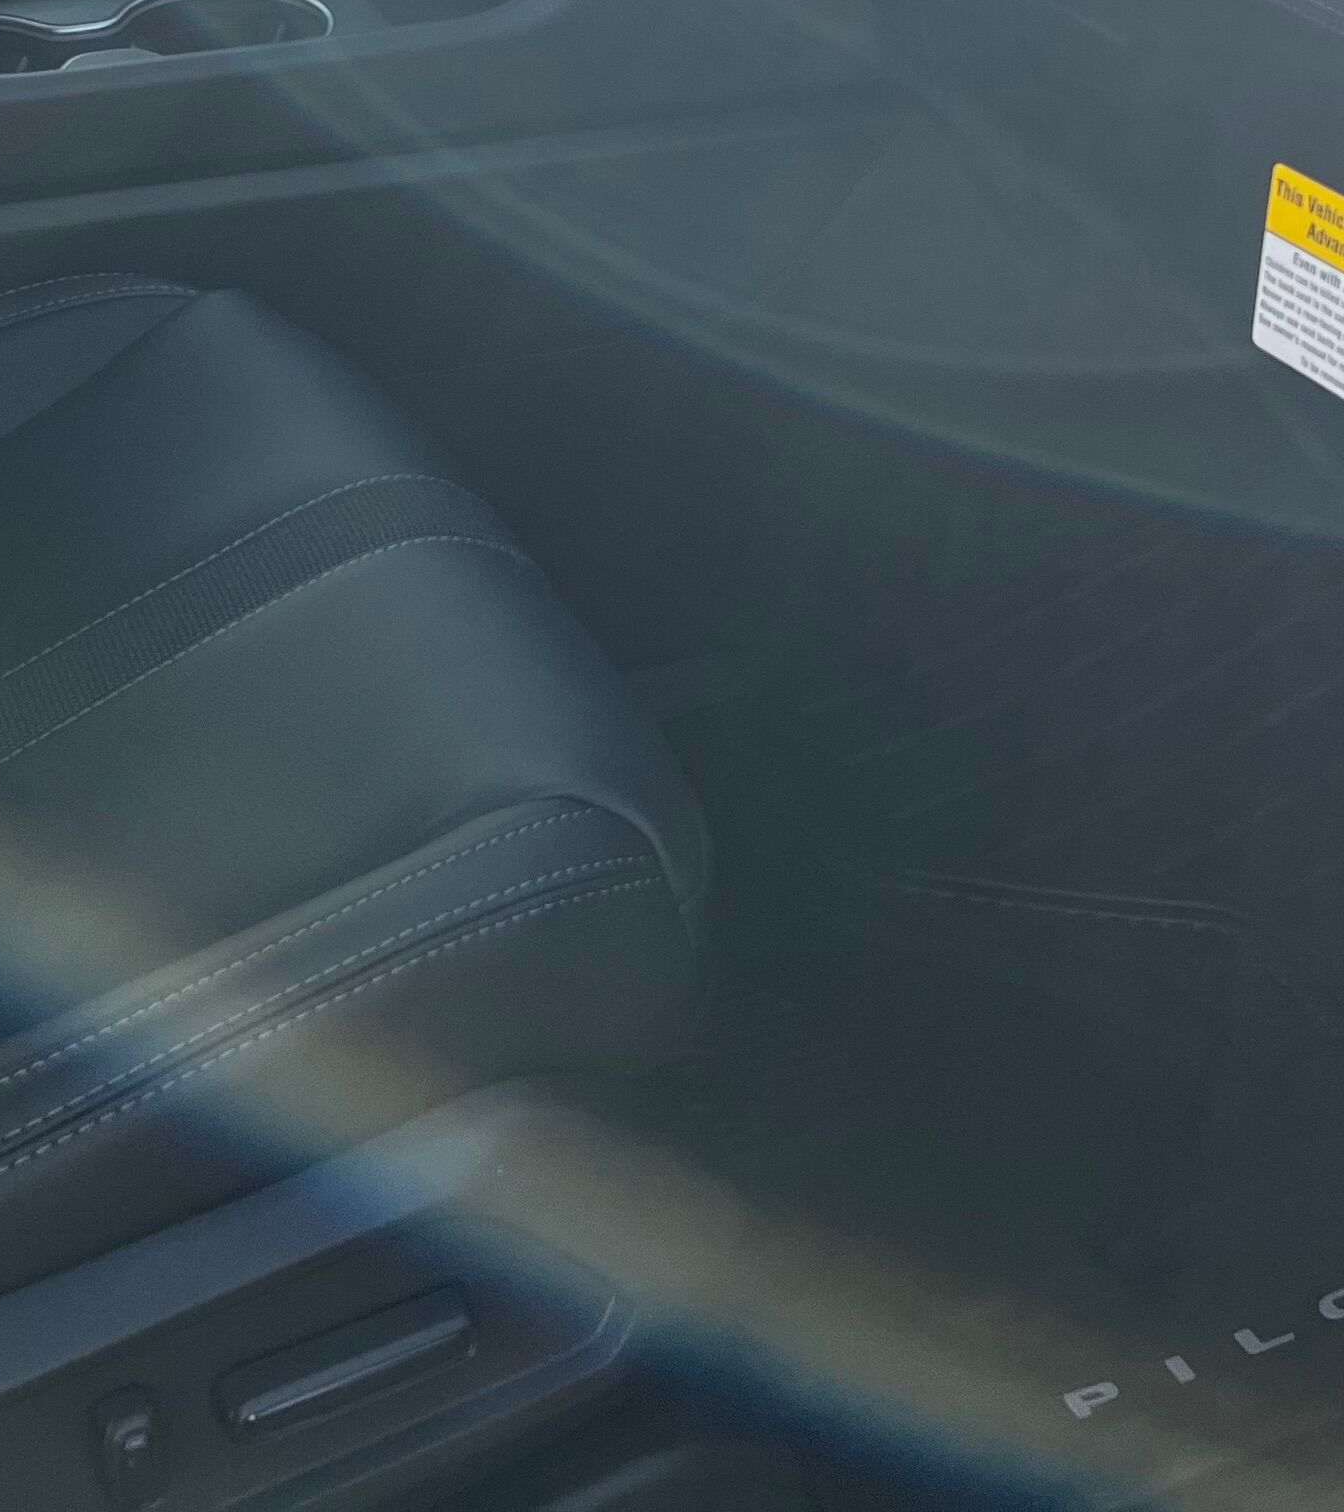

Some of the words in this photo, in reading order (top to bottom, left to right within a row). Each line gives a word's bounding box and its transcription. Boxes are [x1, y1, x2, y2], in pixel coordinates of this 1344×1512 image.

[1275, 178, 1304, 206] This
[1292, 251, 1317, 275] Even
[1319, 269, 1342, 289] with
